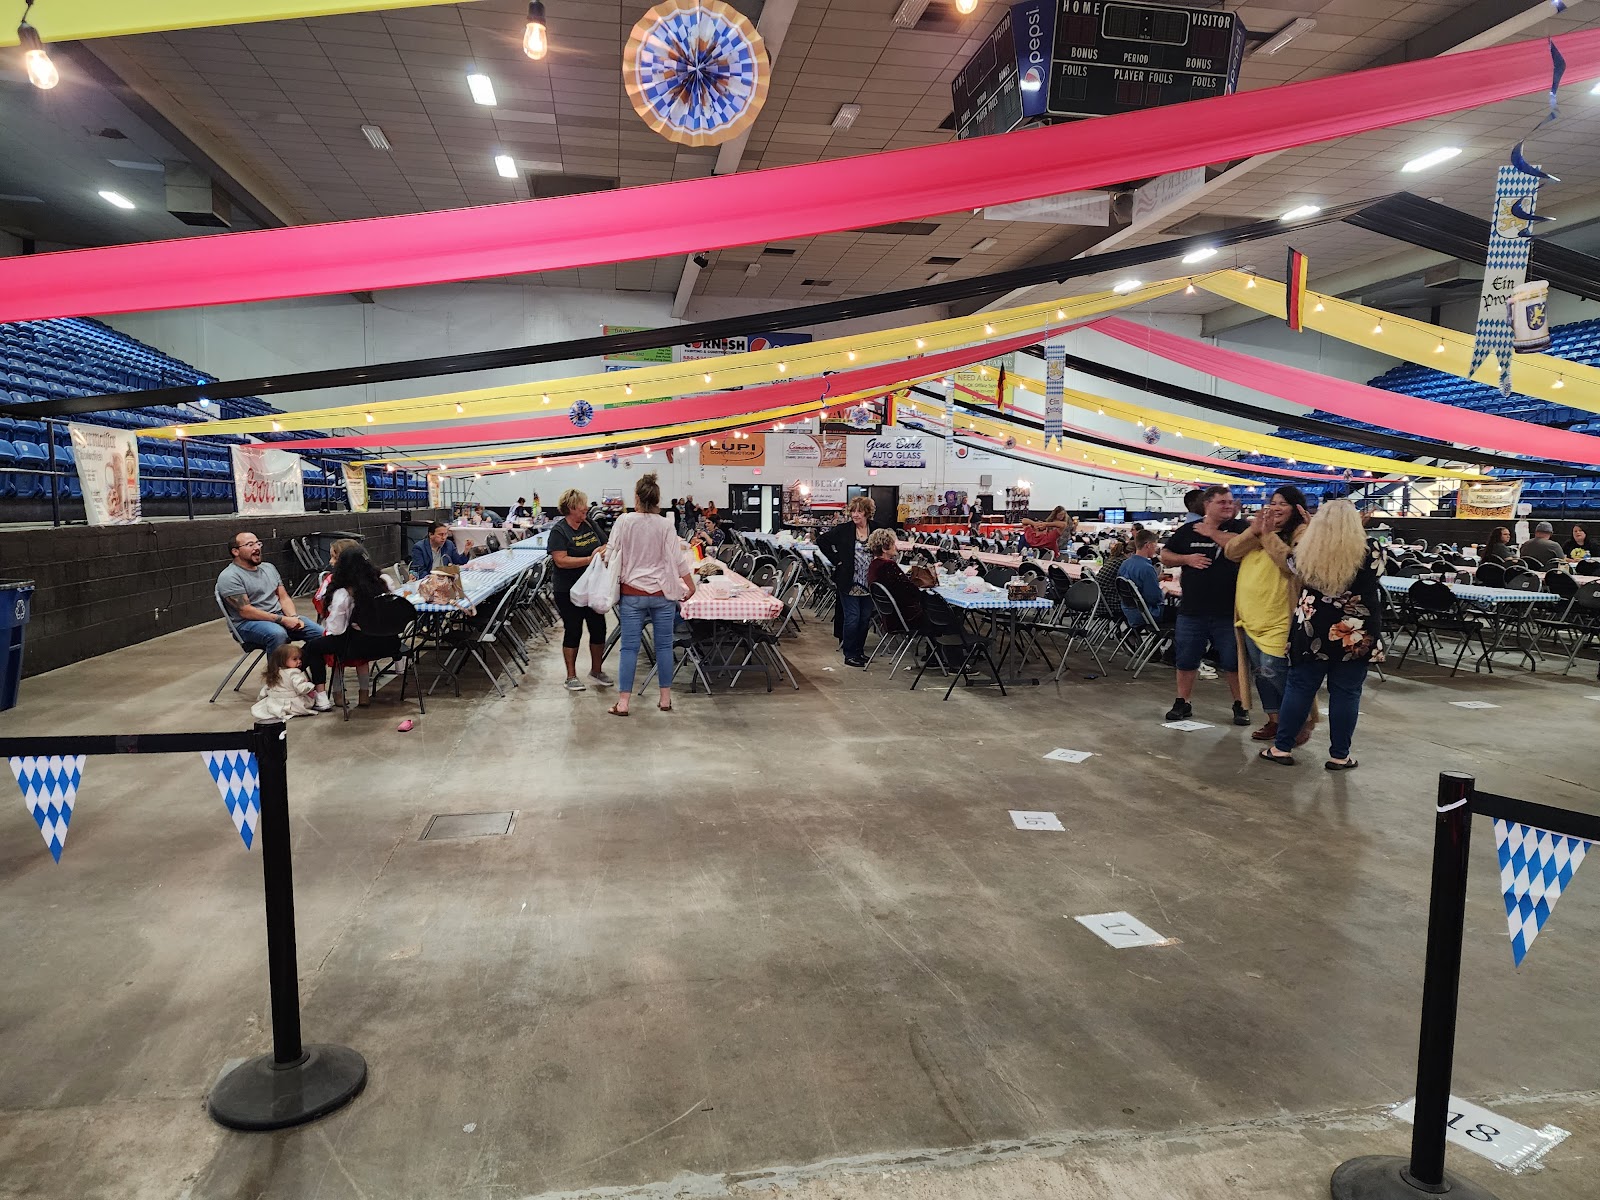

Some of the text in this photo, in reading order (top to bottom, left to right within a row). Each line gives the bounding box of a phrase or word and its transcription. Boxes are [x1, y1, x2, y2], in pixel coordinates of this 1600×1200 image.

[1063, 0, 1100, 15] HOME
[1192, 13, 1231, 29] VISITOR
[1025, 8, 1044, 64] pepsi
[1071, 47, 1098, 60] BONUS
[1123, 52, 1149, 64] PERIOD
[1062, 64, 1088, 77] FOULS
[1185, 57, 1212, 70] BONUS
[1114, 68, 1174, 84] PLAYER FOULS
[1191, 76, 1217, 88] FOULS
[1492, 275, 1514, 290] Ein
[709, 443, 756, 451] LUPI
[866, 437, 922, 453] Gene Burk
[872, 451, 922, 459] AUTO GLASS
[1023, 815, 1046, 826] 16
[1101, 921, 1140, 937] 17
[1447, 1111, 1501, 1143] 18
